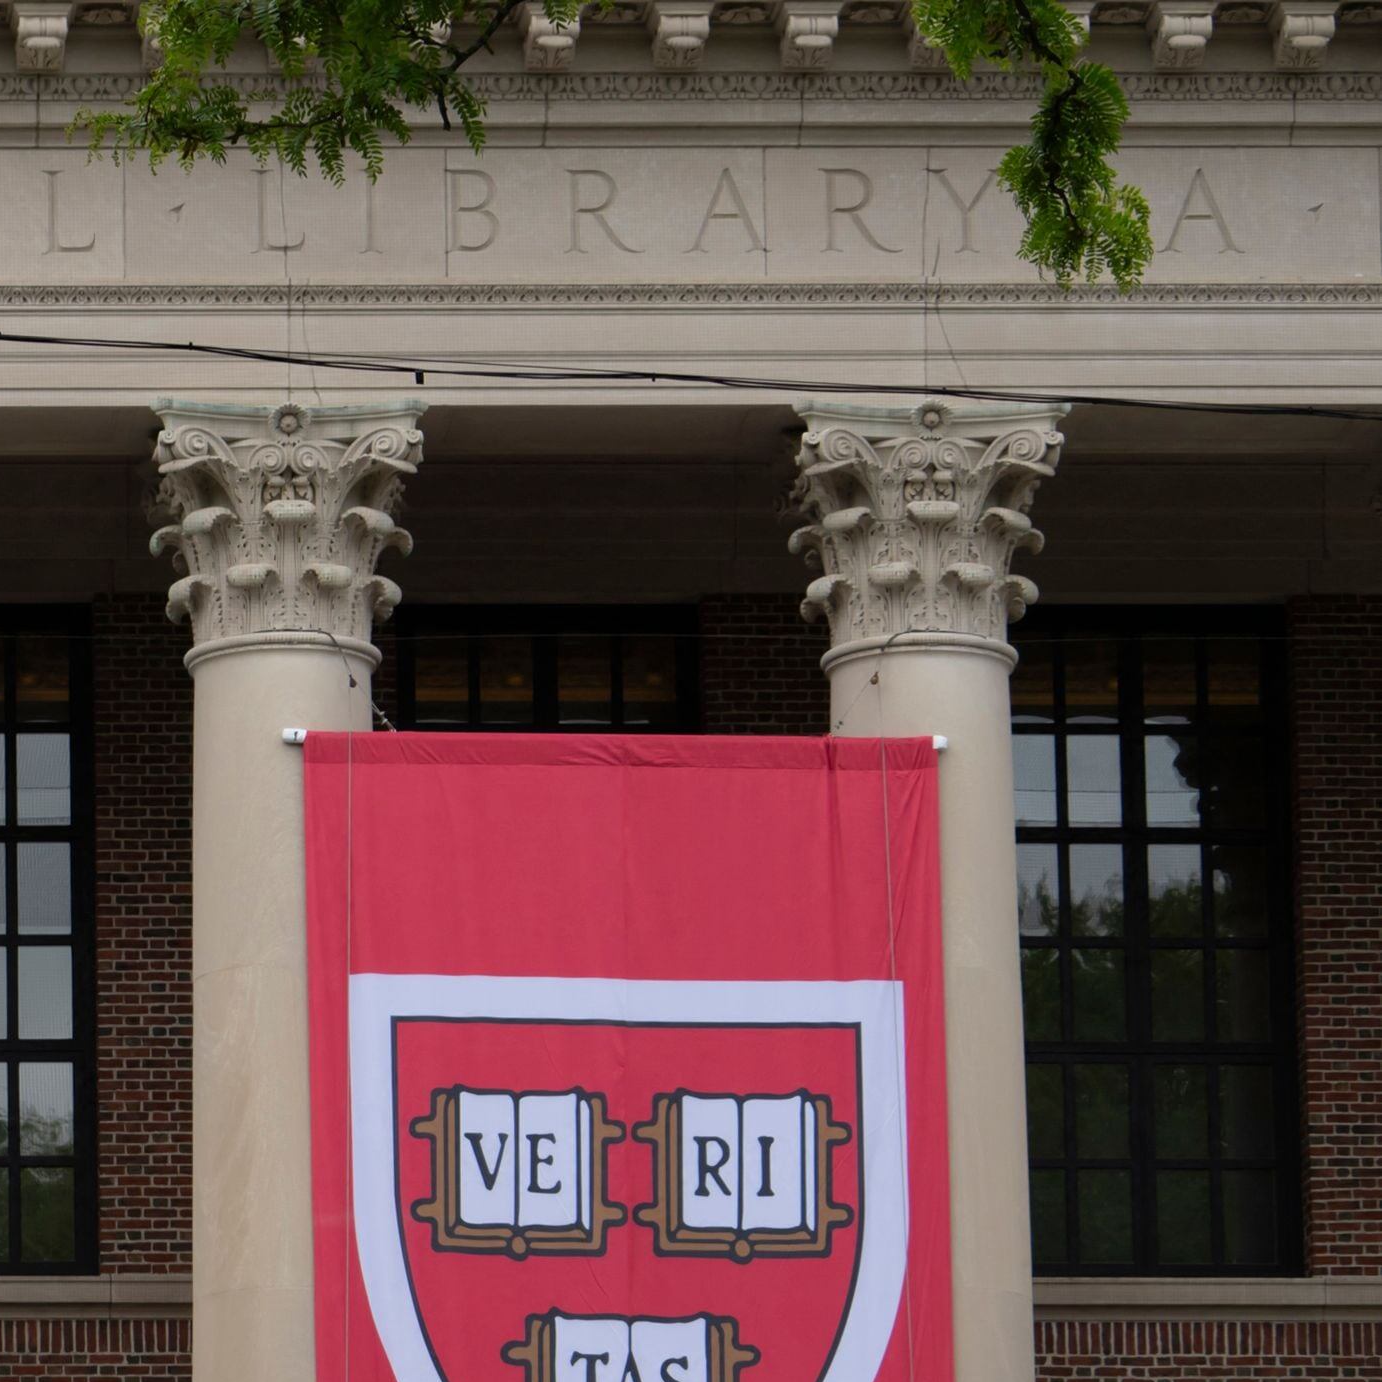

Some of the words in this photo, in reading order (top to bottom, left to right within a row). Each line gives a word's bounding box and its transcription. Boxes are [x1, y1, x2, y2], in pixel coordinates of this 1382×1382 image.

[250, 167, 1000, 256] LIBRARY
[1157, 167, 1246, 256] A
[464, 1132, 562, 1194] VE
[693, 1135, 775, 1197] RI
